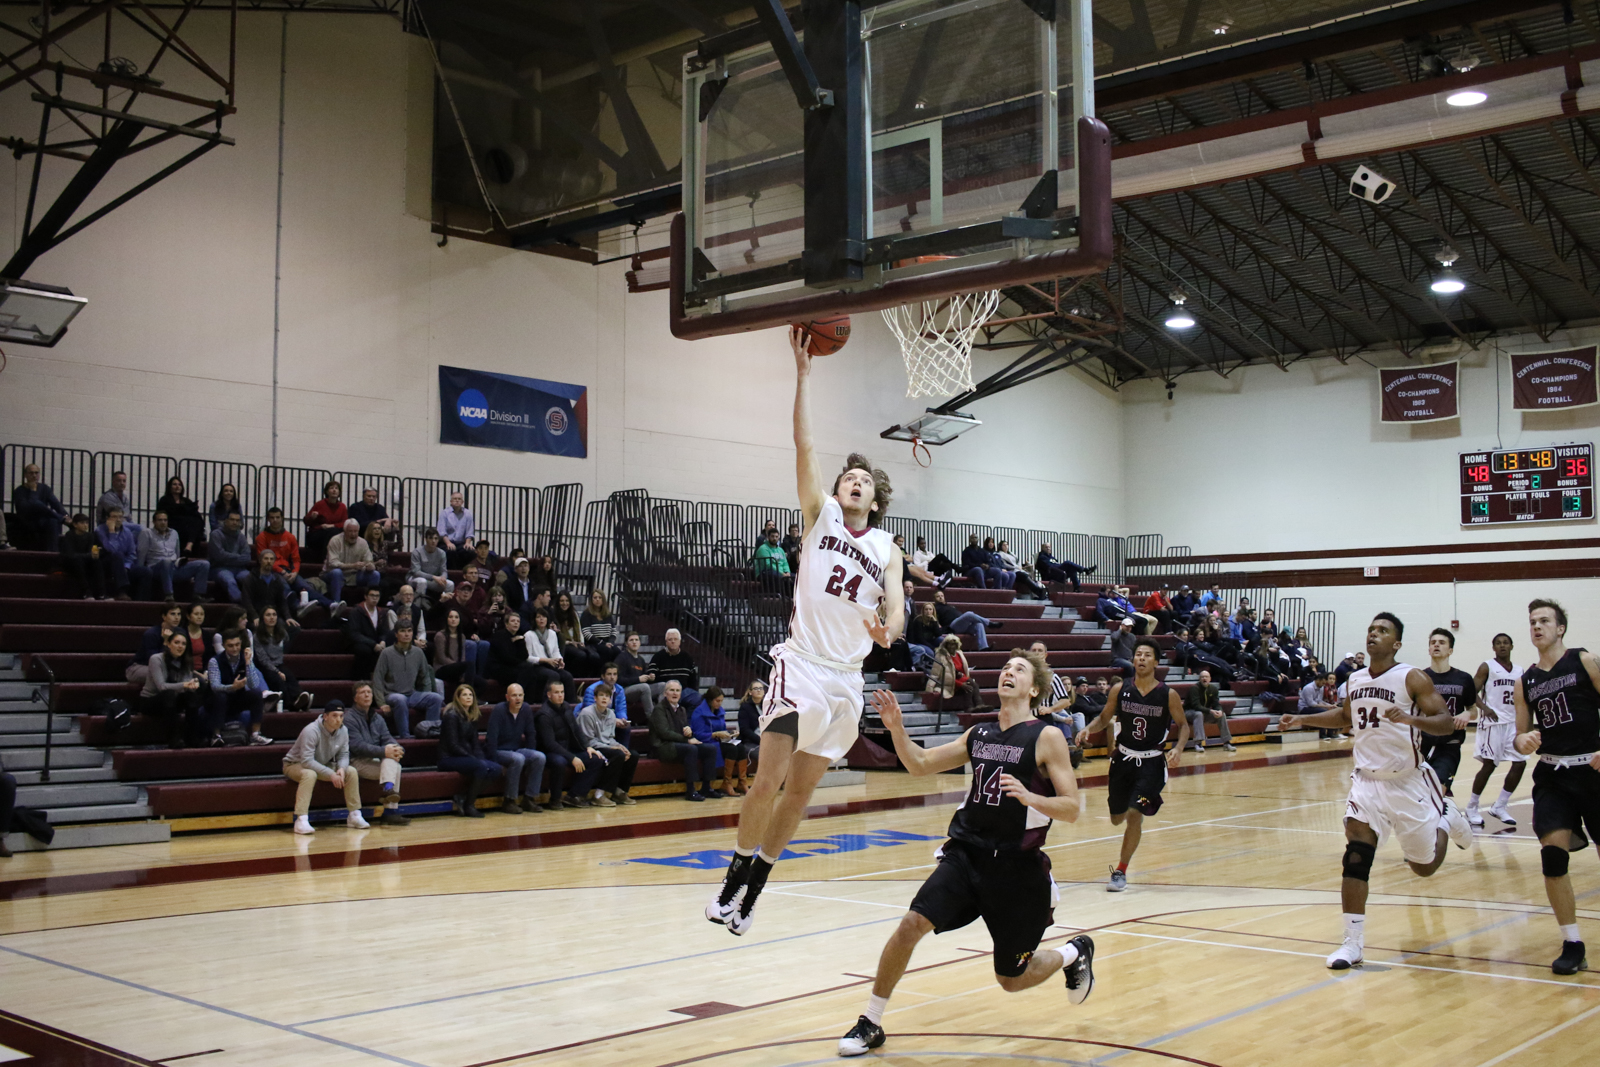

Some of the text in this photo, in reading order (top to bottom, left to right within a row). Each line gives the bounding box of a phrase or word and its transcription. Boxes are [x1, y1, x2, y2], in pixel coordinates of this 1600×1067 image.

[1516, 357, 1592, 379] CENTENNIAL CONFERENCE
[1384, 372, 1453, 392] CENTENNIAL CONFERENCE
[1531, 374, 1578, 384] CO-CHAMPIONS
[1398, 387, 1440, 397] CO-CHAMPIONS
[1538, 395, 1572, 404] FOOTBALL
[459, 405, 488, 420] NCAA
[490, 409, 522, 423] Division
[1403, 408, 1435, 417] FOOTBALL
[1557, 446, 1590, 457] VISITOR
[1464, 454, 1487, 464] HOME
[1468, 465, 1489, 482] 48
[1566, 458, 1588, 476] 36
[1473, 484, 1493, 492] BONUS
[1507, 479, 1530, 487] PERIOD
[1532, 475, 1540, 489] 2
[1557, 479, 1578, 487] BONUS
[1480, 503, 1488, 515] 4
[1572, 497, 1581, 510] 3
[825, 564, 864, 603] 24
[1537, 691, 1573, 729] 31
[1357, 706, 1380, 730] 34
[1132, 716, 1147, 741] 3
[973, 763, 1004, 806] 14
